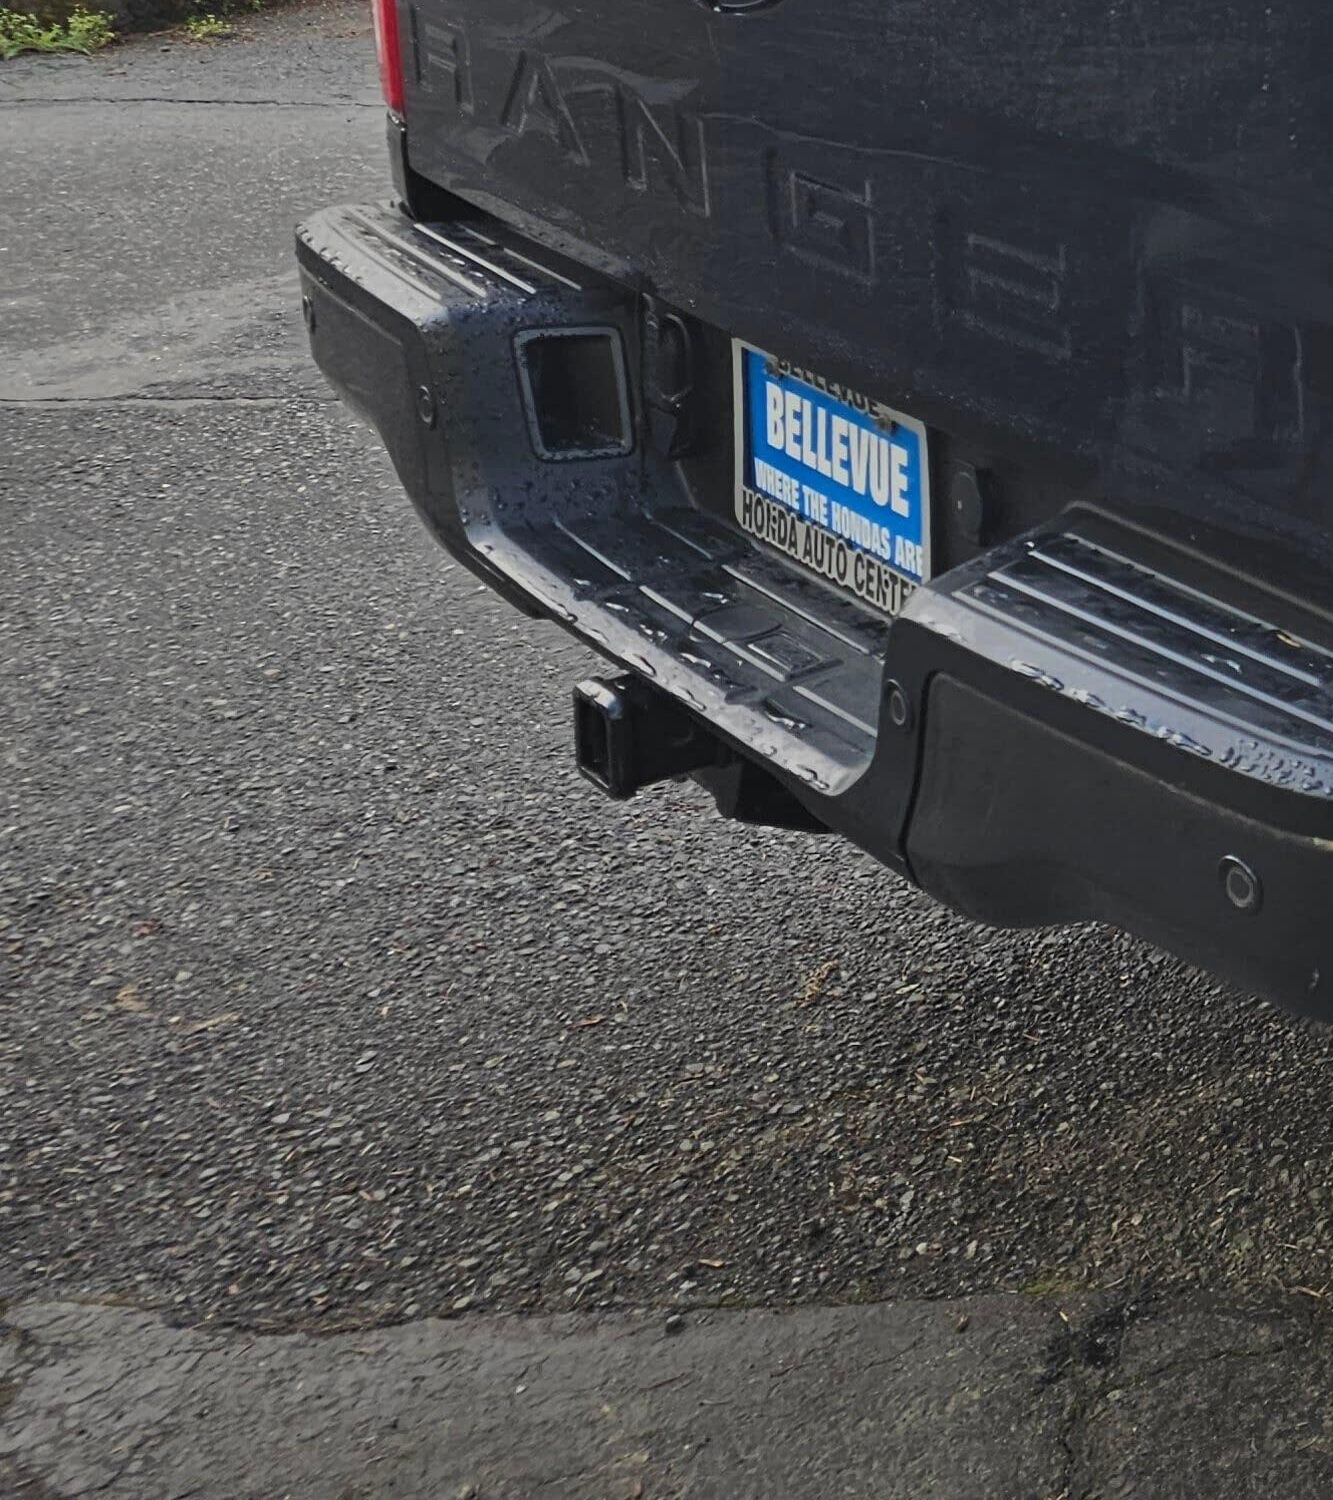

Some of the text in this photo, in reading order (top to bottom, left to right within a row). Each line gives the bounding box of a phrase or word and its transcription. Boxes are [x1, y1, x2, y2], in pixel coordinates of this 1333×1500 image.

[766, 380, 910, 518] BELLEVUE
[741, 488, 917, 615] HONDA AUTO CENTE
[754, 456, 923, 577] WHERE THE HONDAS ARE
